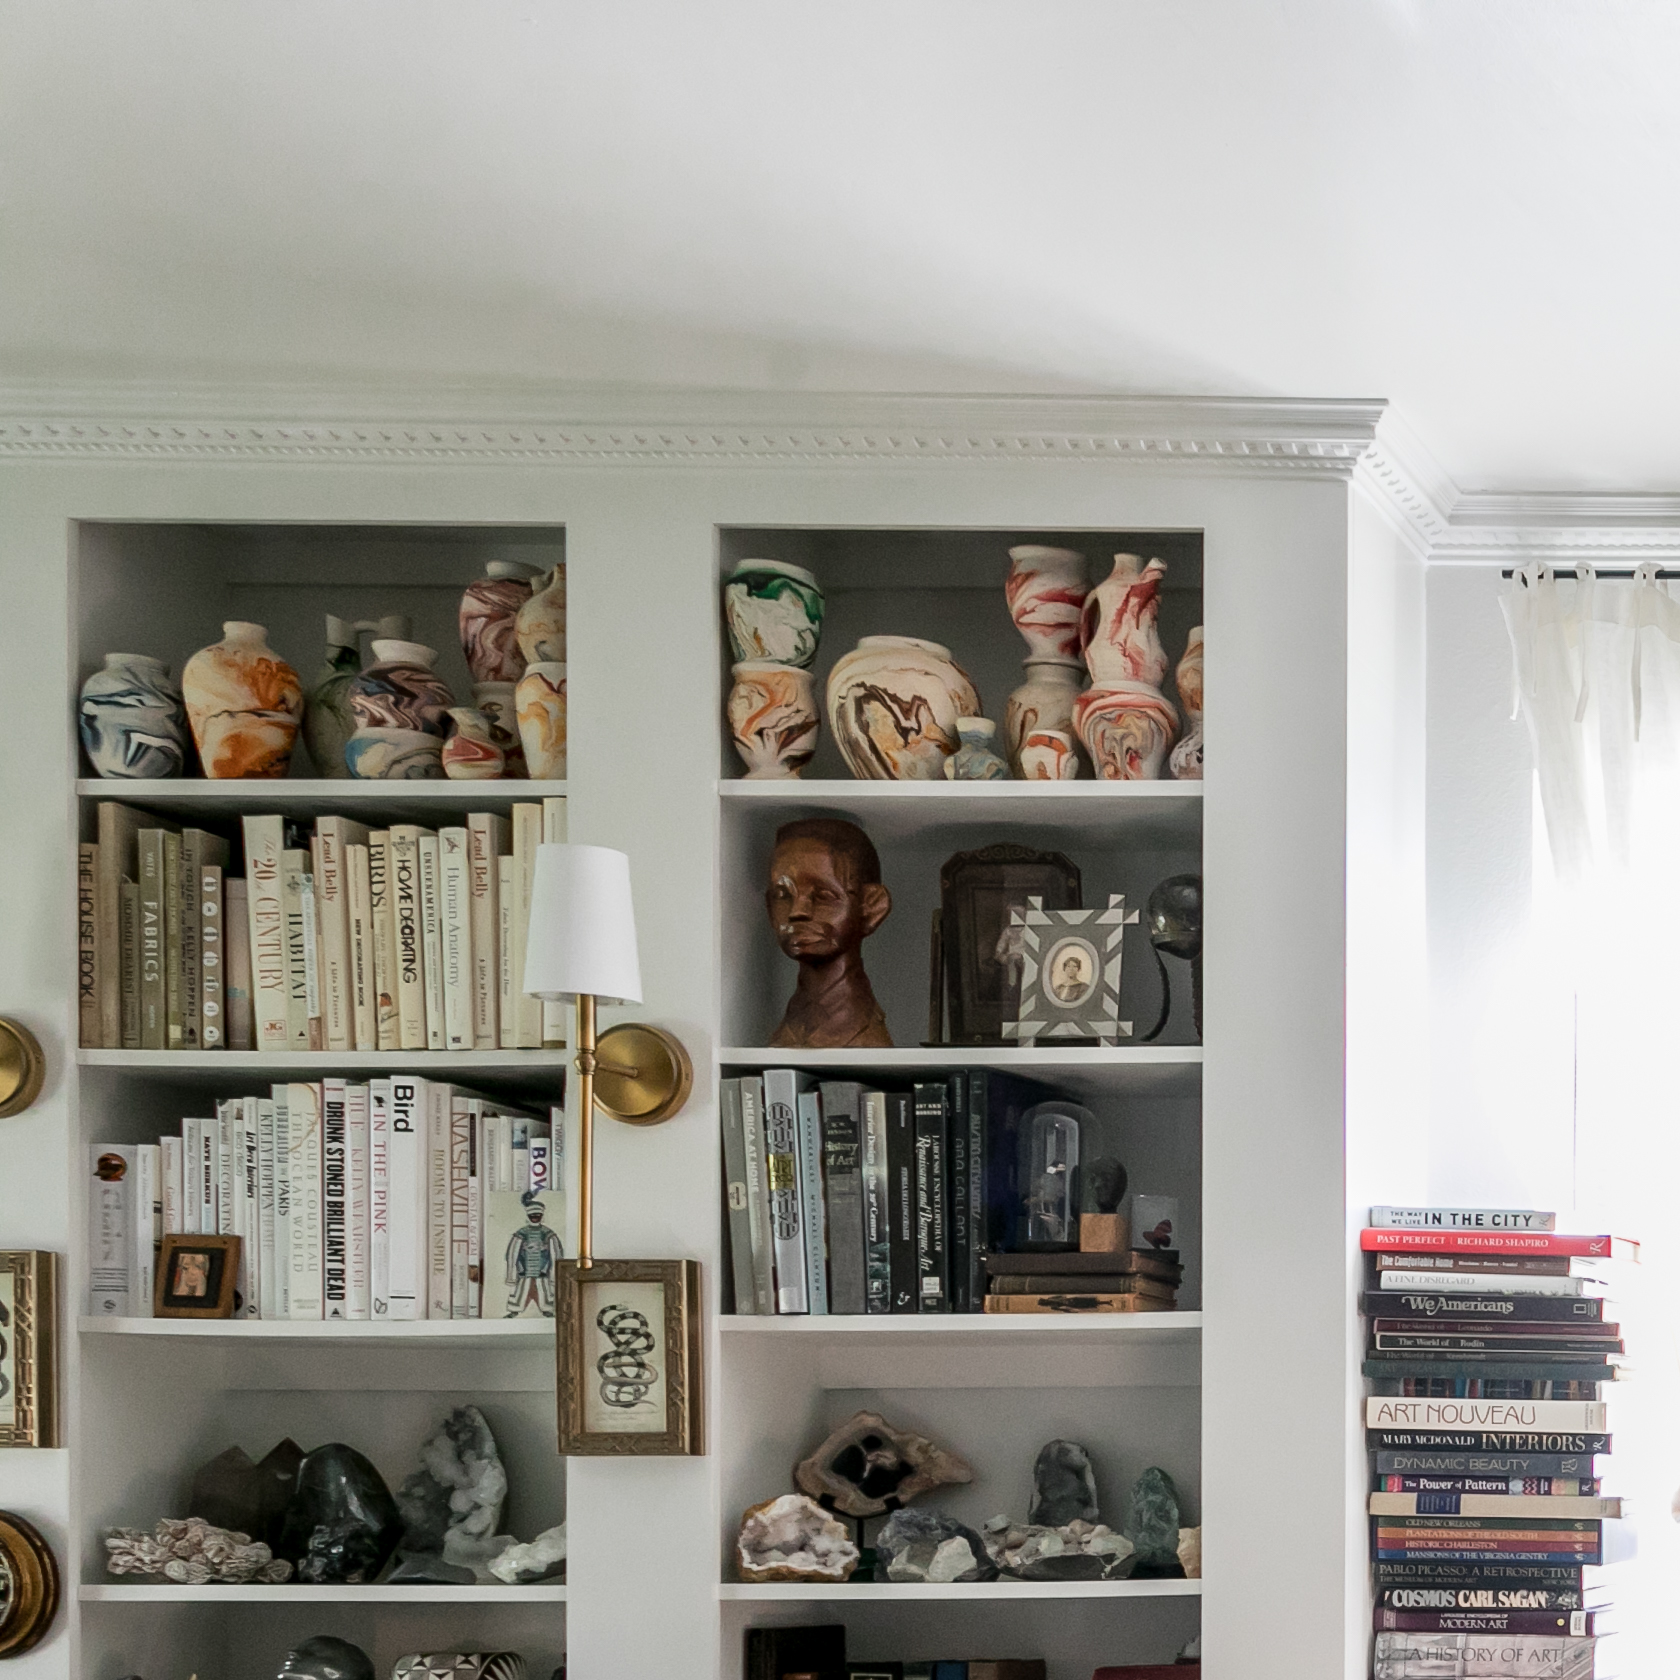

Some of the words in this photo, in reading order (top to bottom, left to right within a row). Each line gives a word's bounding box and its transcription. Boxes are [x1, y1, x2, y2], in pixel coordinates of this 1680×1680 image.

[322, 833, 335, 863] Lead
[473, 830, 486, 860] Lead
[80, 852, 93, 882] THE
[370, 844, 386, 907] BIRDS
[473, 866, 488, 899] Belly
[323, 869, 337, 901] Belly
[447, 867, 460, 919] Human
[81, 889, 94, 944] HOUSE
[144, 902, 158, 981] FABRICS
[256, 897, 284, 993] CENTURY
[288, 913, 306, 999] HABITAT
[447, 923, 460, 987] Anatomy
[81, 950, 95, 998] BOOK
[326, 1102, 344, 1144] DRUNK
[374, 1114, 386, 1131] IN
[394, 1085, 414, 1132] Bird
[745, 1092, 755, 1139] AMERICA
[374, 1142, 386, 1176] THE
[749, 1145, 756, 1158] AT
[327, 1148, 344, 1196] STONED
[433, 1149, 445, 1195] ROOMS
[452, 1112, 468, 1254] NASHVILLE
[750, 1162, 759, 1193] HOME
[374, 1190, 386, 1233] PINK
[434, 1200, 445, 1218] TO
[1425, 1213, 1442, 1225] IN
[1450, 1214, 1484, 1226] THE
[1492, 1214, 1532, 1227] CITY
[327, 1201, 344, 1264] BRILLIANT
[1377, 1236, 1400, 1244] PAST
[1403, 1236, 1446, 1245] PERFECT
[1457, 1238, 1503, 1246] RICHARD
[1505, 1239, 1548, 1247] SHAPIRO
[434, 1224, 445, 1276] INSPIRE
[327, 1268, 344, 1300] DEAD
[1402, 1296, 1434, 1310] We
[1427, 1298, 1514, 1315] Americans
[1378, 1403, 1421, 1422] ART
[1427, 1404, 1536, 1425] NOUVEAU
[1382, 1434, 1411, 1444] MARY
[1416, 1435, 1474, 1445] MCDONALD
[1482, 1433, 1586, 1451] INTERIORS
[1394, 1457, 1464, 1470] DYNAMIC
[1469, 1459, 1529, 1471] BEAUTY
[1419, 1479, 1453, 1490] Power
[1455, 1482, 1462, 1490] of
[1465, 1479, 1506, 1490] Pattern
[1392, 1590, 1455, 1607] COSMOS
[1458, 1590, 1496, 1607] CARL
[1498, 1591, 1548, 1608] SAGAN
[1439, 1619, 1485, 1628] MODERN
[1488, 1619, 1508, 1629] ART
[1409, 1649, 1422, 1660] A
[1427, 1649, 1496, 1662] HISTORY
[1501, 1649, 1523, 1662] OF
[1528, 1649, 1560, 1662] ART
